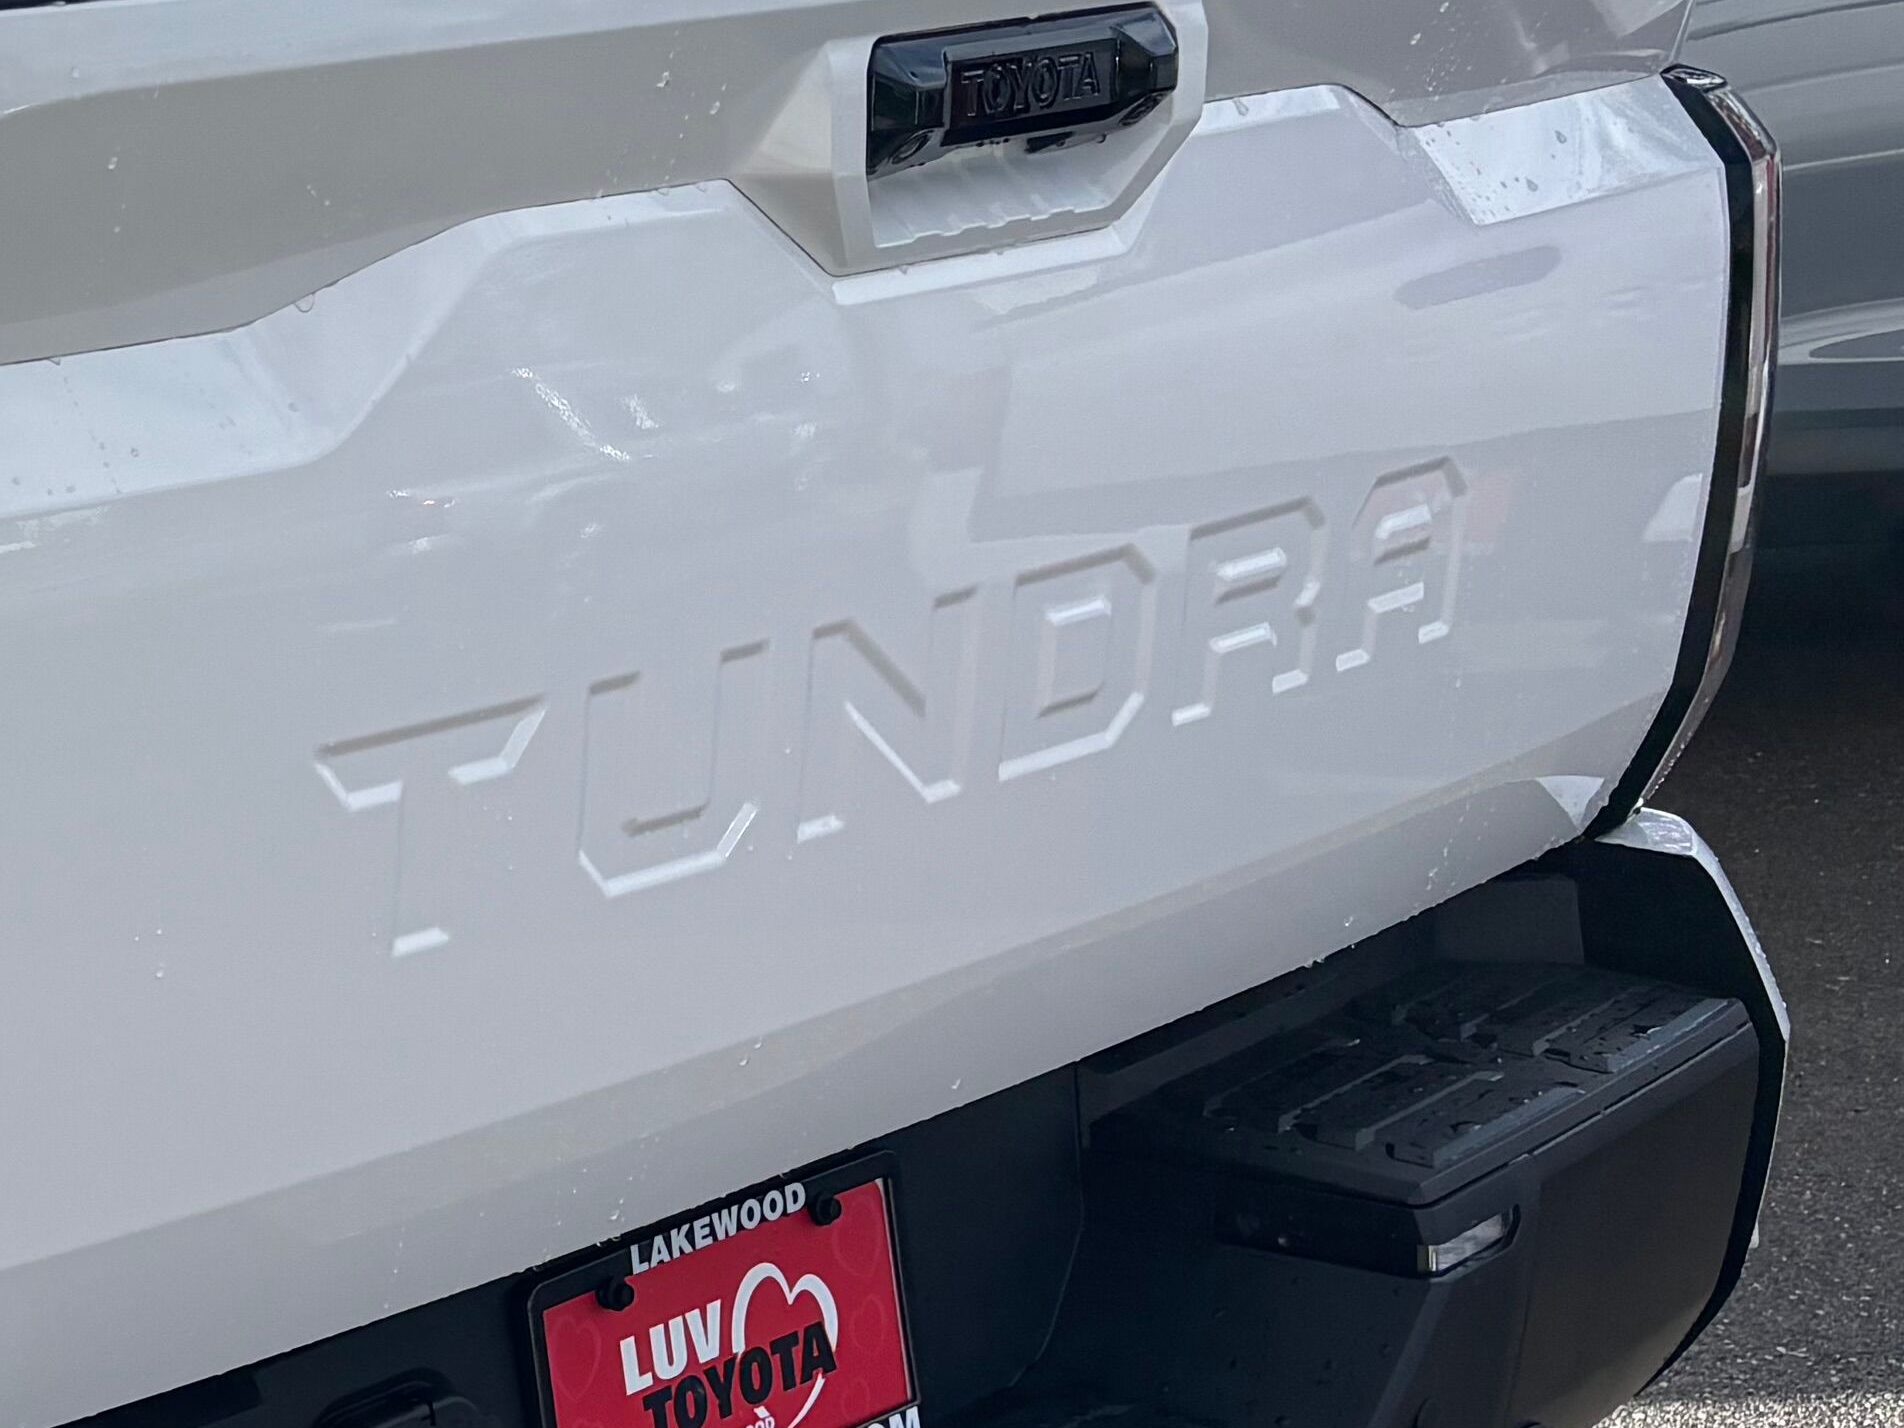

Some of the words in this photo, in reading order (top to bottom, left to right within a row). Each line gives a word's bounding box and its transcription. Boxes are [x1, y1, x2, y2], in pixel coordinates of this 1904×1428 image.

[961, 52, 1102, 117] TOYOTA
[312, 457, 1467, 958] TUNDRA
[630, 1180, 807, 1276] LAKEWOOD
[619, 1298, 725, 1397] LUV
